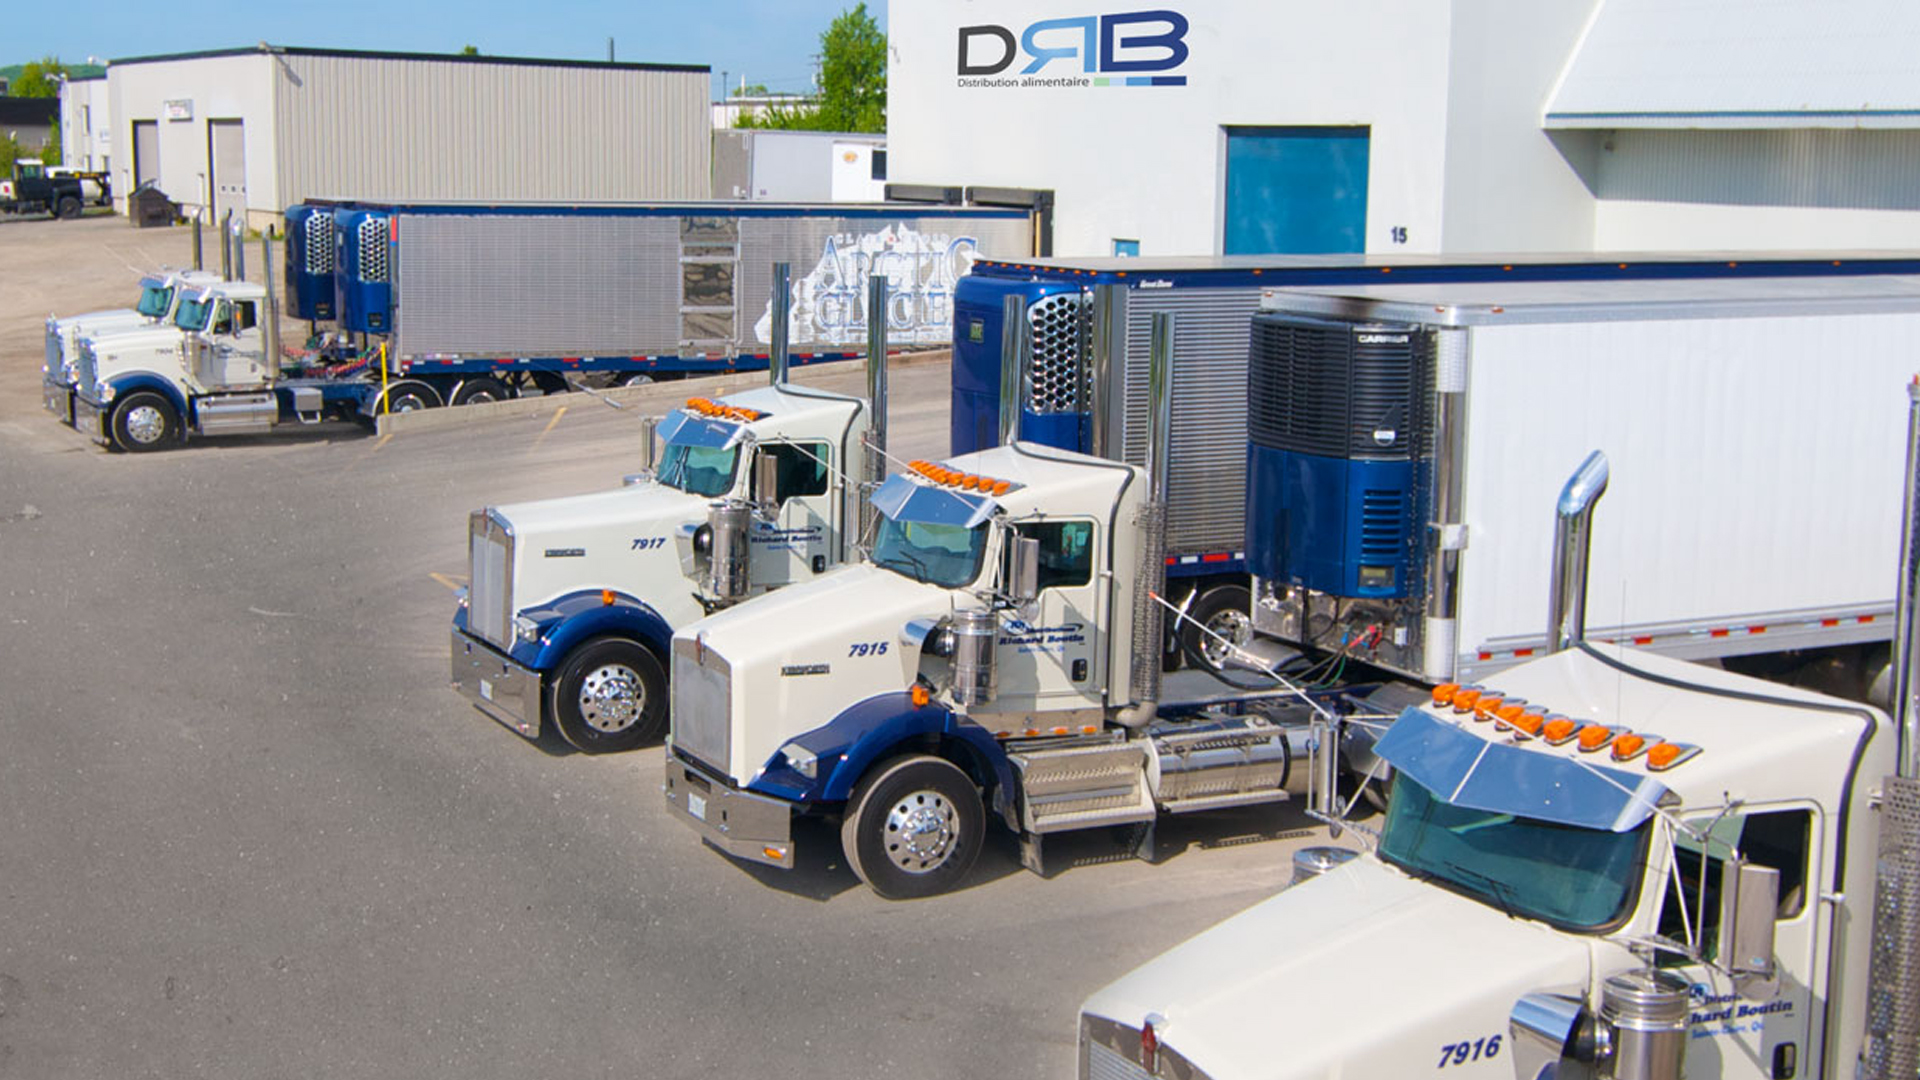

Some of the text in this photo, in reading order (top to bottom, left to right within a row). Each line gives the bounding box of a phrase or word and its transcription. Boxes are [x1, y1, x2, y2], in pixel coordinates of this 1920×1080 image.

[957, 77, 1090, 88] Distribution alimentaire
[1391, 226, 1407, 244] 15
[631, 537, 666, 550] 7917
[848, 641, 889, 658] 7915
[1690, 1000, 1793, 1024] hard Boutin
[1438, 1034, 1502, 1069] 7916
